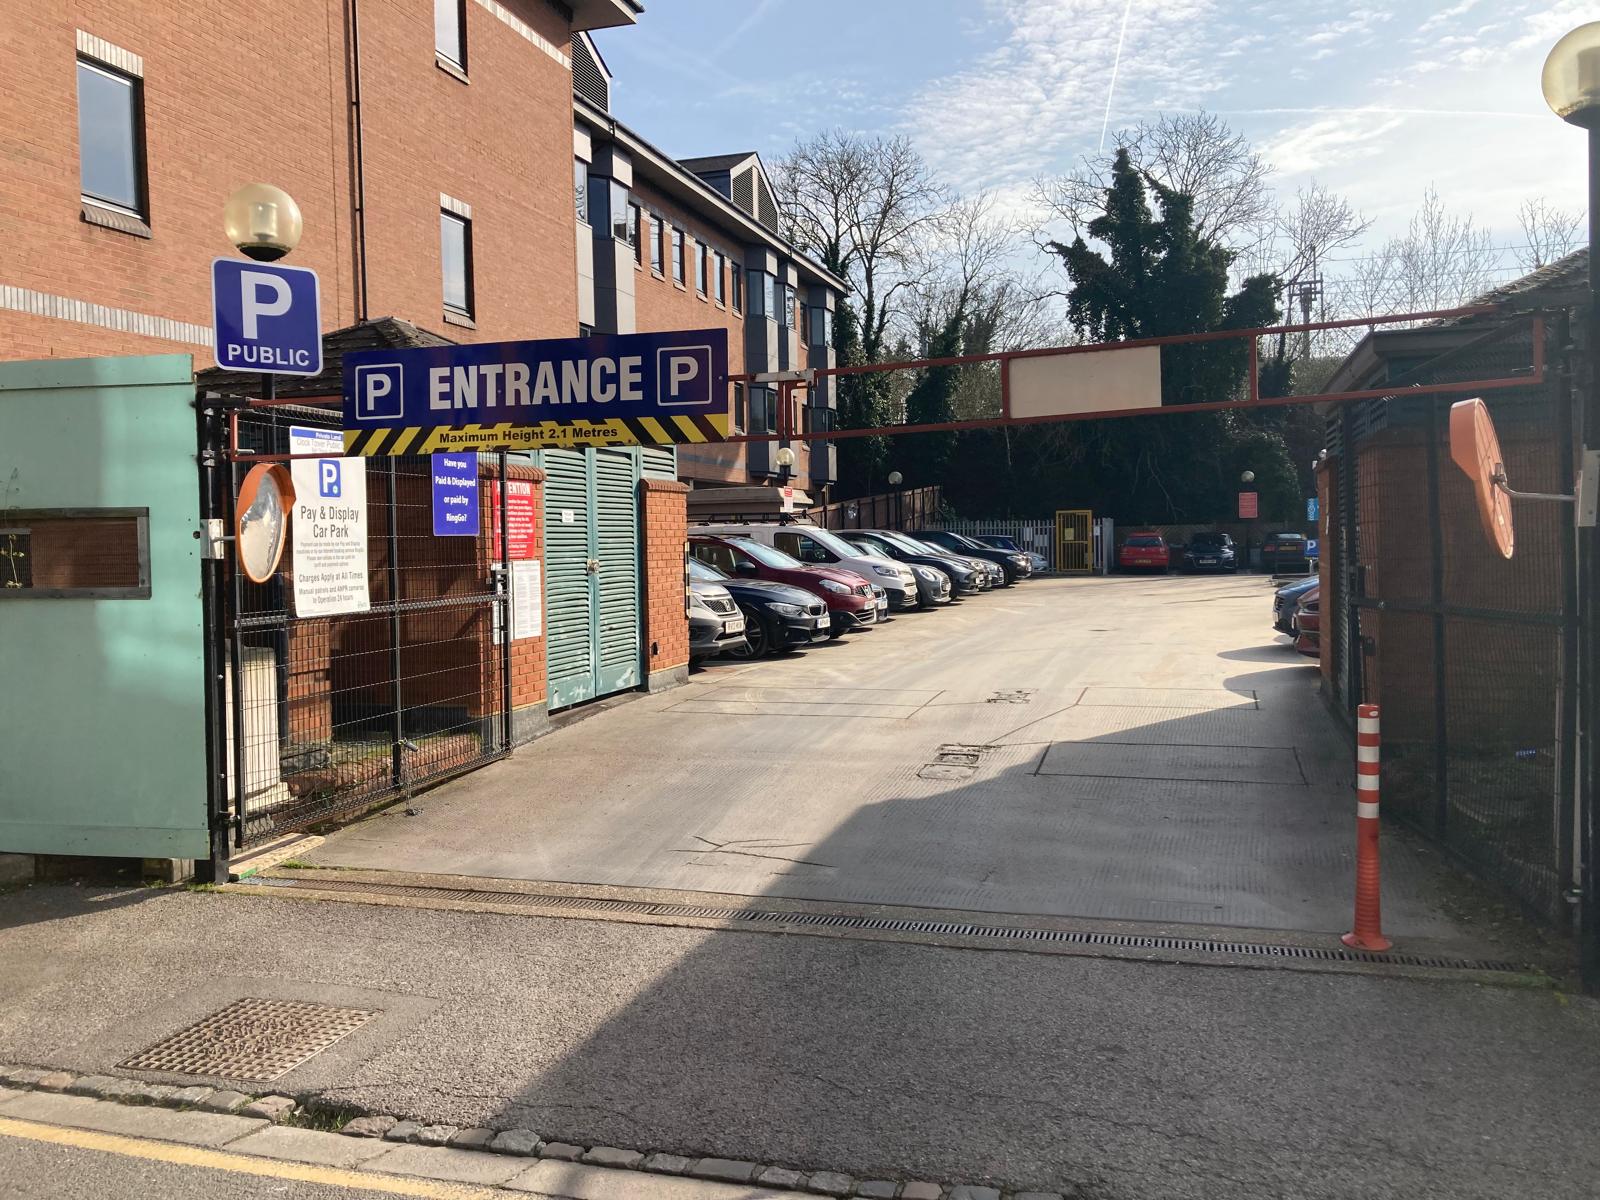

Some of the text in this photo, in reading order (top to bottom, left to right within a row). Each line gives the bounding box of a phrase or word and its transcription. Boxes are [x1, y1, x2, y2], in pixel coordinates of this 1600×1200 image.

[241, 270, 292, 340] P
[227, 343, 310, 367] PUBLIC
[429, 355, 643, 410] ENTRANCE
[670, 356, 699, 396] P
[366, 373, 392, 411] P
[439, 426, 618, 445] Maximum Height 2.1 Metres
[444, 458, 467, 469] Have you
[322, 463, 337, 493] P
[435, 476, 476, 488] Paid & Displayed
[450, 496, 461, 505] paid
[462, 496, 469, 505] by
[300, 505, 359, 523] Pay & Display
[446, 513, 467, 523] RingGo?
[313, 524, 349, 538] Car Park
[298, 574, 320, 583] Charges
[321, 573, 335, 583] Apply
[349, 571, 364, 579] Times
